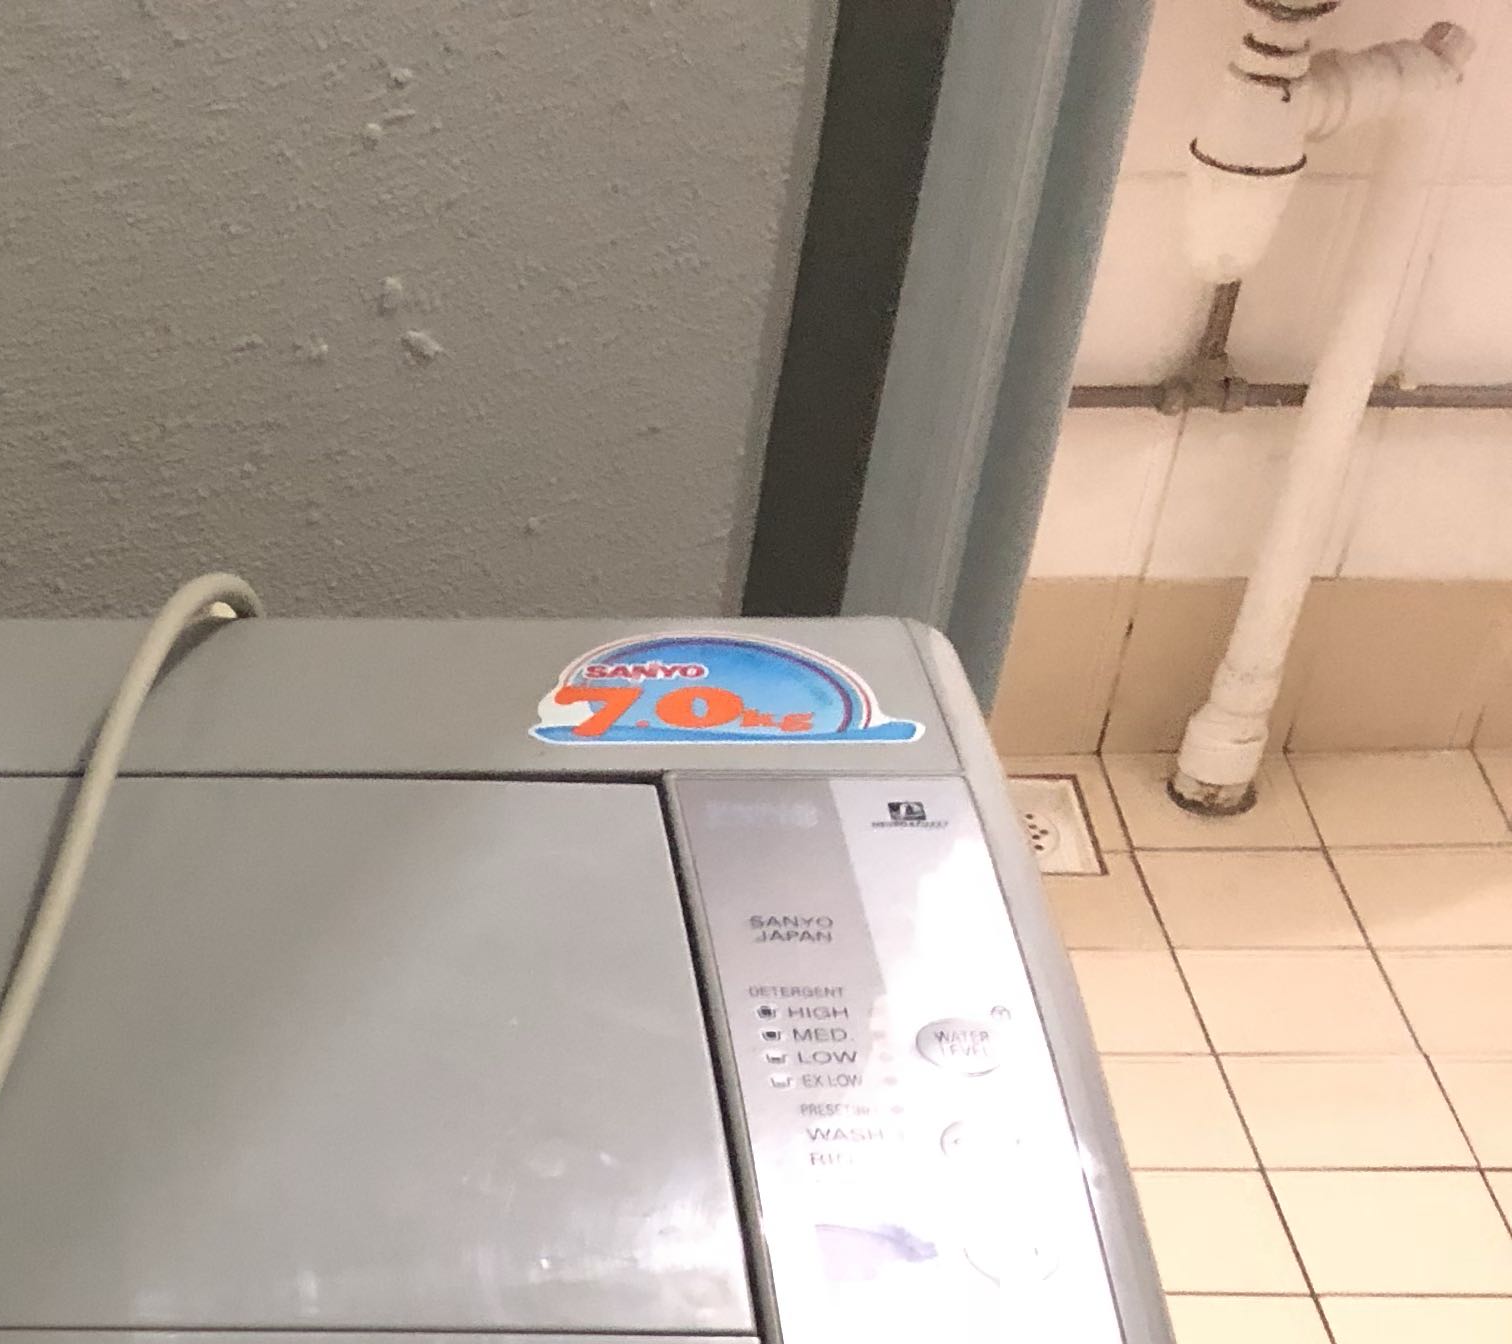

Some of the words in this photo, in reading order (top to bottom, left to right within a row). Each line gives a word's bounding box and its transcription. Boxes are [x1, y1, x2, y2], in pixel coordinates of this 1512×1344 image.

[584, 663, 708, 682] SANYO
[750, 915, 834, 929] SANYO
[755, 930, 833, 943] JAPAN
[749, 985, 844, 998] DETERGENT
[788, 1007, 849, 1019] HIGH
[797, 1051, 858, 1064] LOW
[802, 1074, 826, 1088] EX
[829, 1074, 863, 1088] LOW
[806, 1127, 884, 1142] WASH
